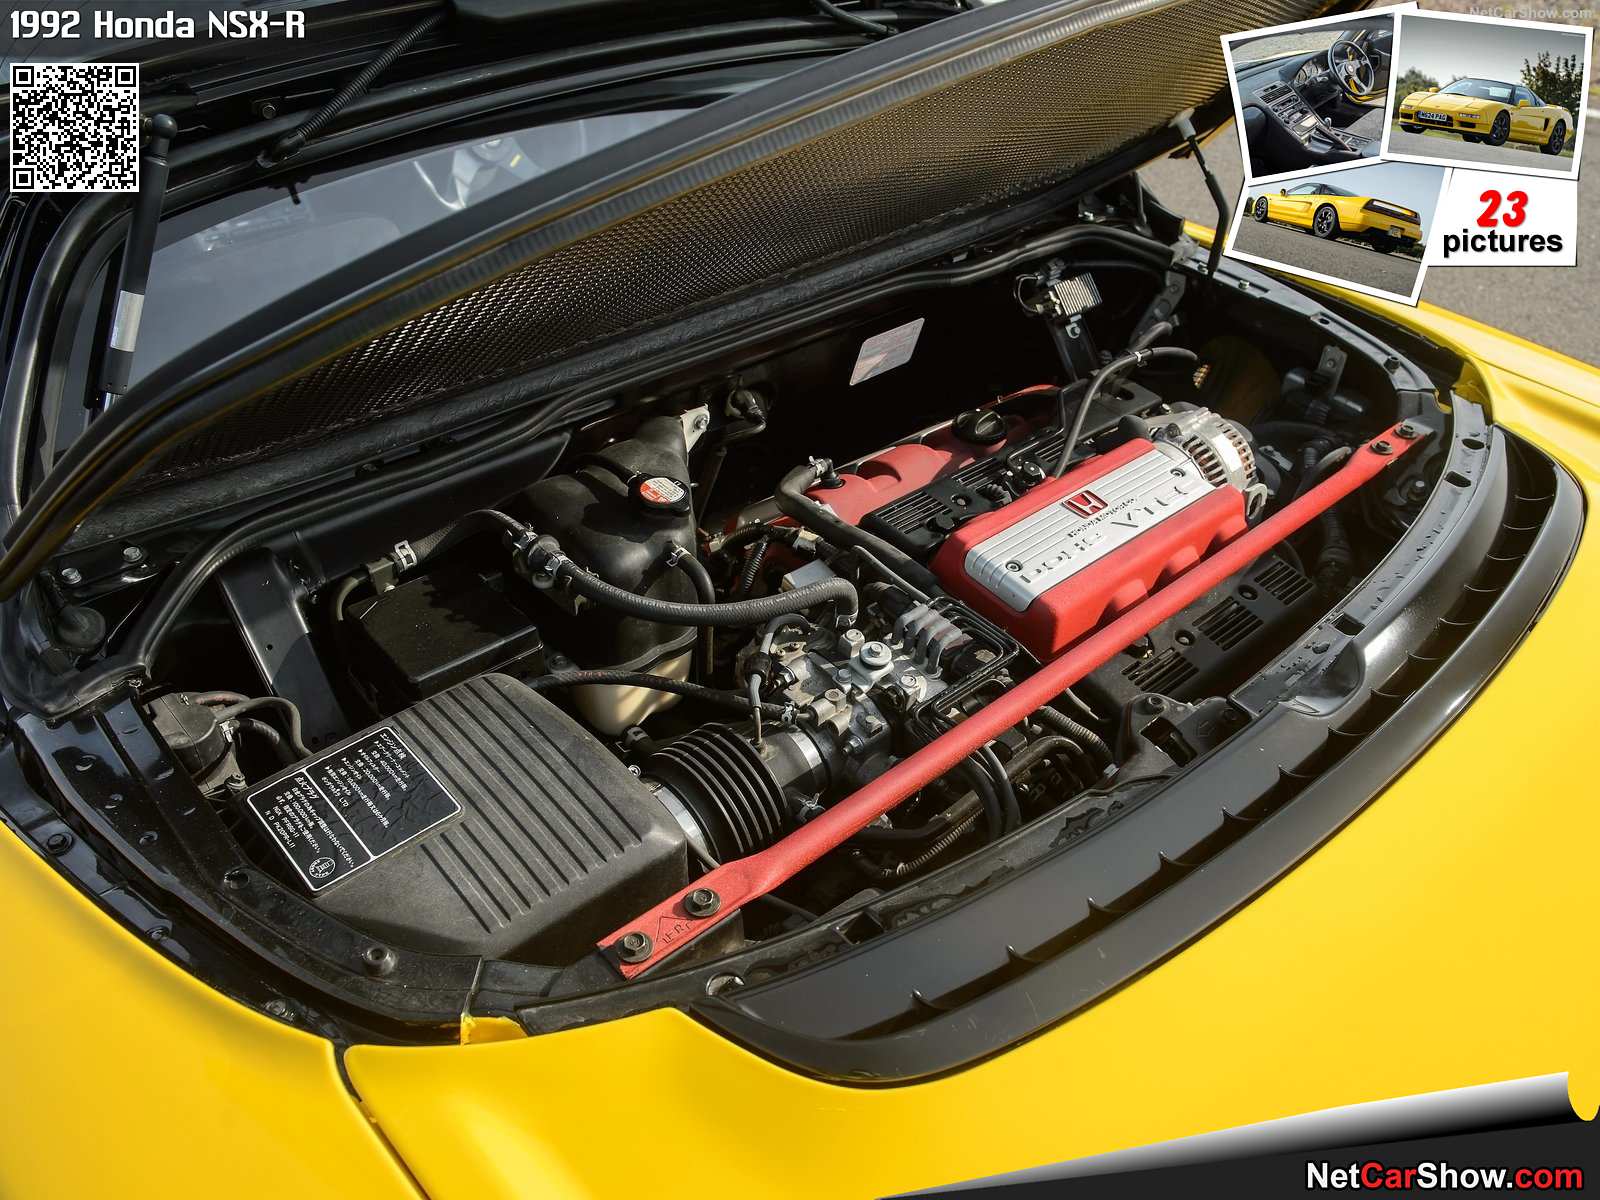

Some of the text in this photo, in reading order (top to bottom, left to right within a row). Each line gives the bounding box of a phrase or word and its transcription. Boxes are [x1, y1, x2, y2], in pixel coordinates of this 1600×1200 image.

[293, 774, 320, 802] 点火プラグ
[337, 796, 350, 808] LTD
